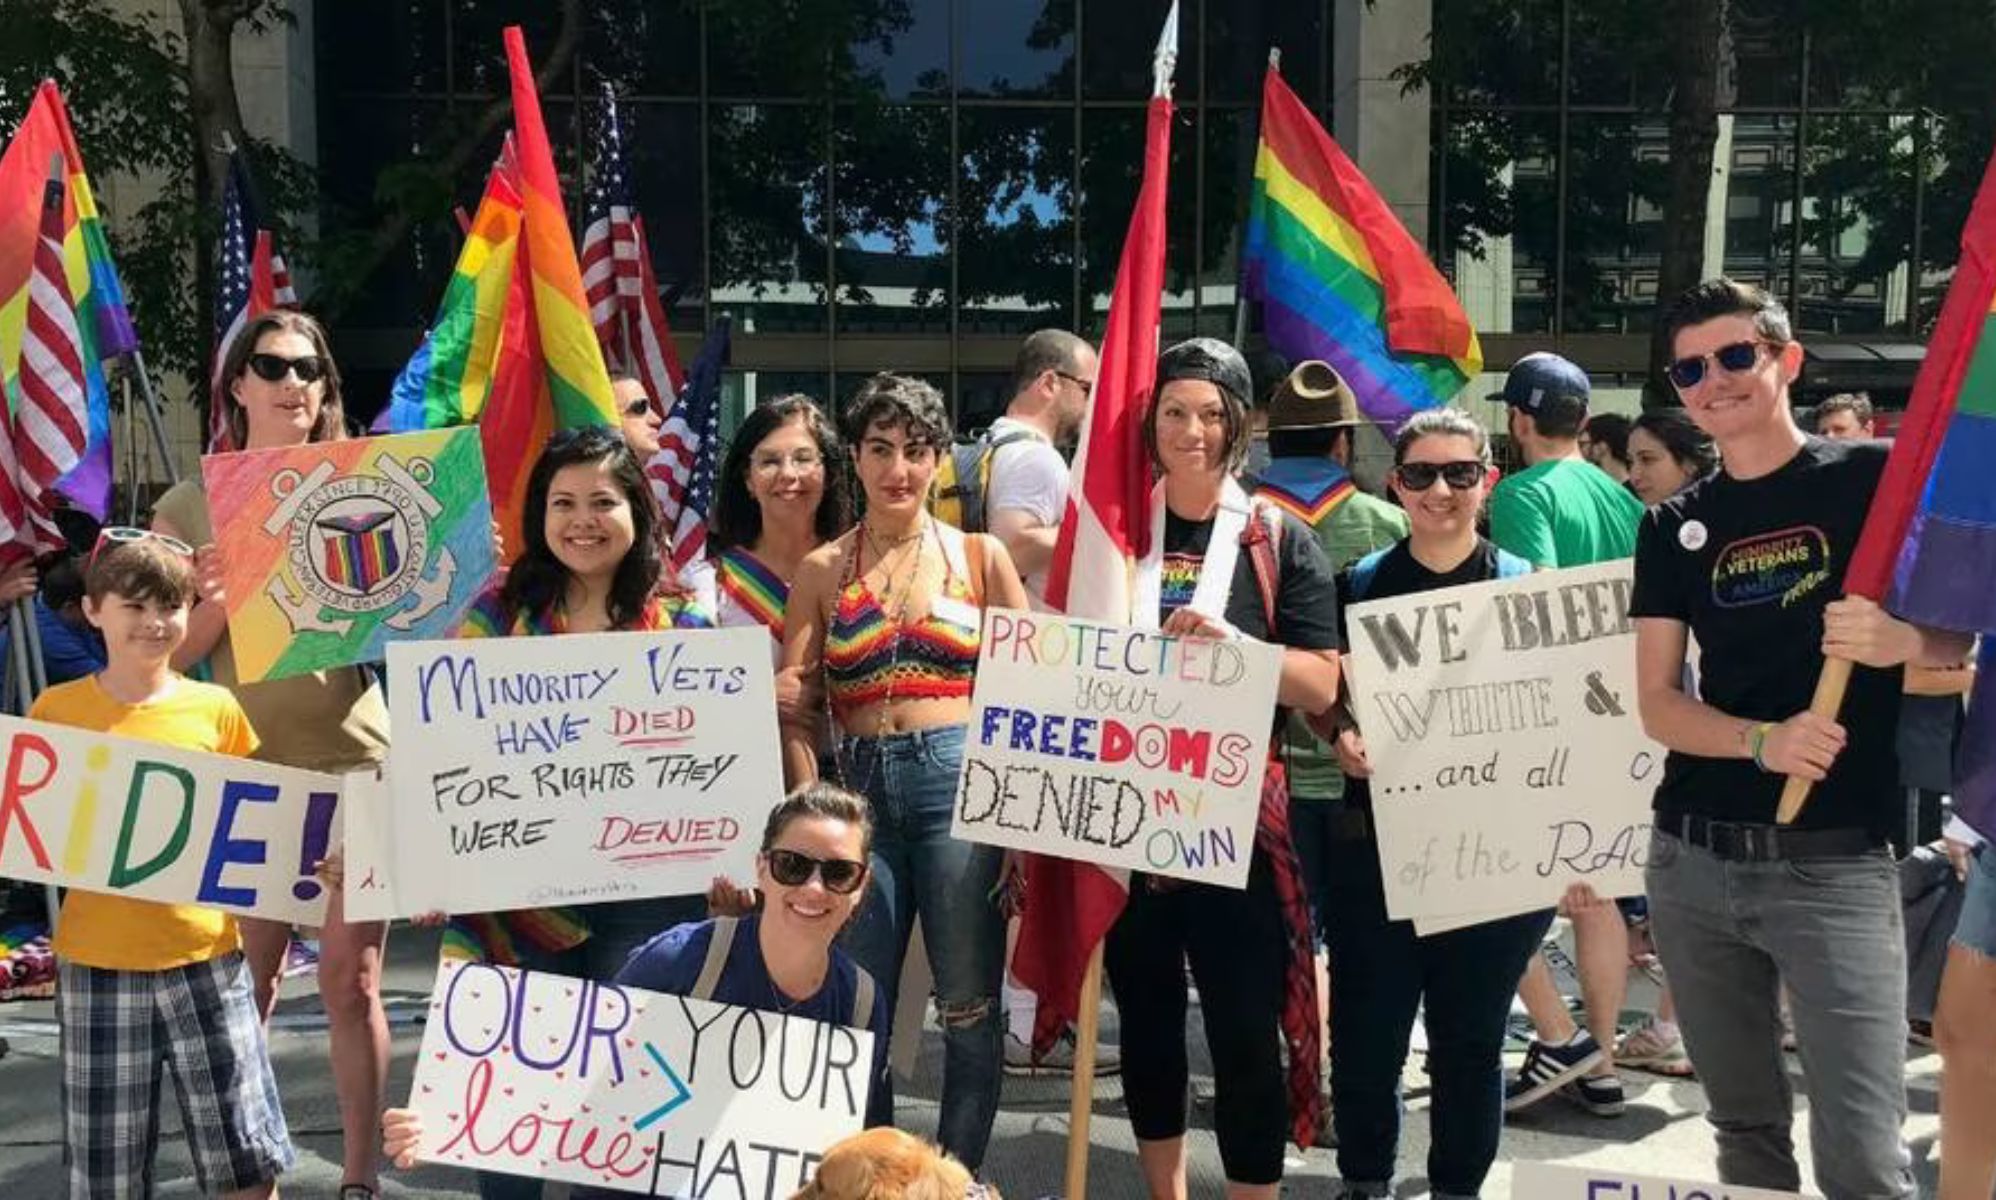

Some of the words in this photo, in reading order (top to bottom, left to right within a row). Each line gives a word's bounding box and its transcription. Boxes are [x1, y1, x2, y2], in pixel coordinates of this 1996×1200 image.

[313, 479, 367, 507] SINCE
[1727, 546, 1809, 575] VETERANS
[988, 615, 1246, 687] PROTECTED
[1359, 602, 1467, 673] WE
[1075, 674, 1182, 719] your
[1374, 677, 1559, 743] WHITE
[1584, 669, 1627, 717] &
[495, 712, 590, 756] HAVE
[609, 705, 696, 737] DIED
[980, 706, 1252, 788] FREEDOMS
[432, 765, 521, 813] FOR
[532, 761, 635, 798] RIGHTS
[647, 753, 739, 792] THEY
[1525, 747, 1571, 789] all
[961, 758, 1147, 849] DENIED
[1153, 788, 1205, 818] MY
[449, 817, 557, 856] WERE
[593, 816, 739, 851] DENIED
[1146, 826, 1237, 870] OWN
[1399, 836, 1438, 896] of
[1455, 831, 1521, 881] the
[443, 961, 630, 1083] OUR
[679, 994, 858, 1116] YOUR
[437, 1058, 648, 1178] love
